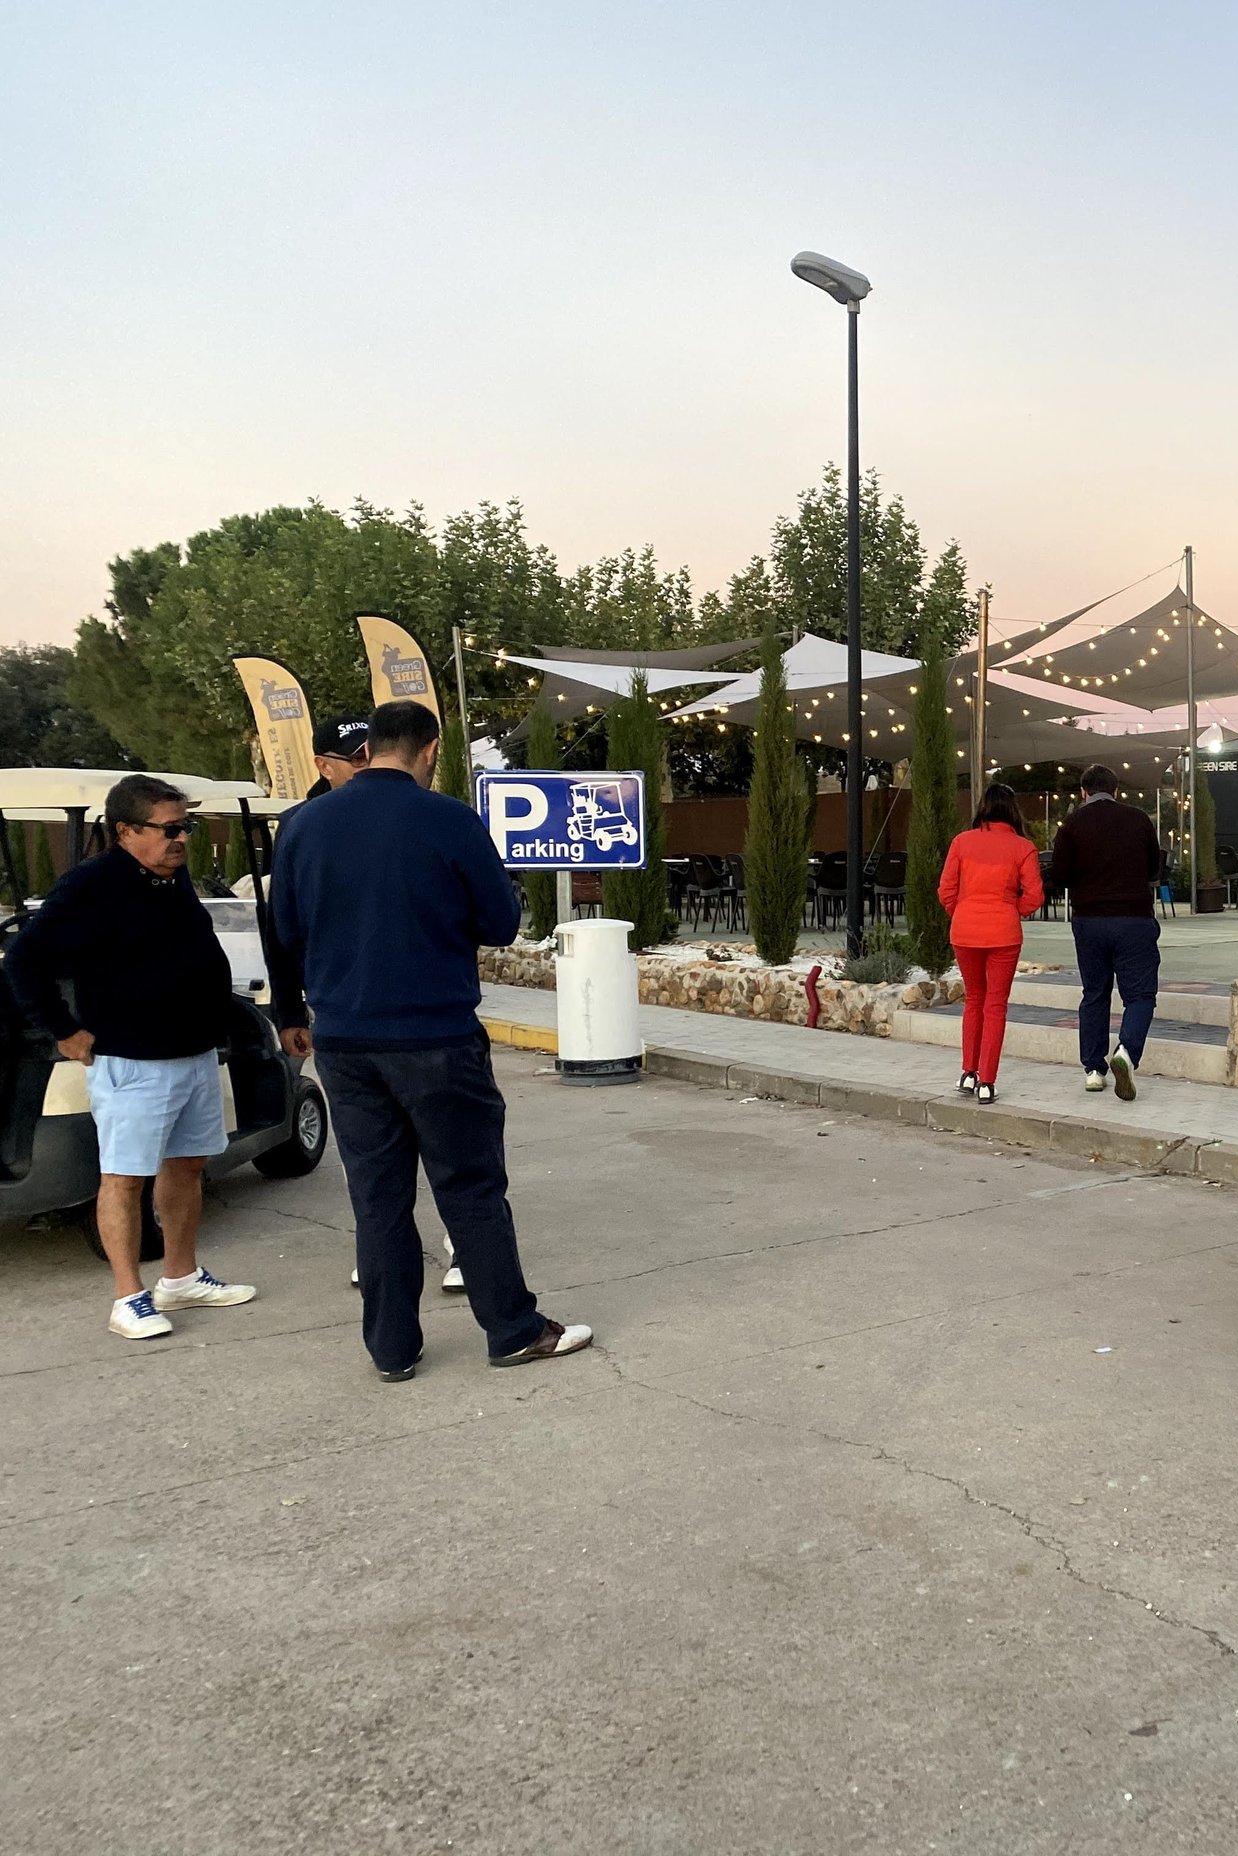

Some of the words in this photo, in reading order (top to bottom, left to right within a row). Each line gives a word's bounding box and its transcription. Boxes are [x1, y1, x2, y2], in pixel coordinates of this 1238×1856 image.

[337, 722, 369, 738] SRIXO
[1197, 761, 1218, 772] EEN
[1219, 761, 1237, 771] SIRE
